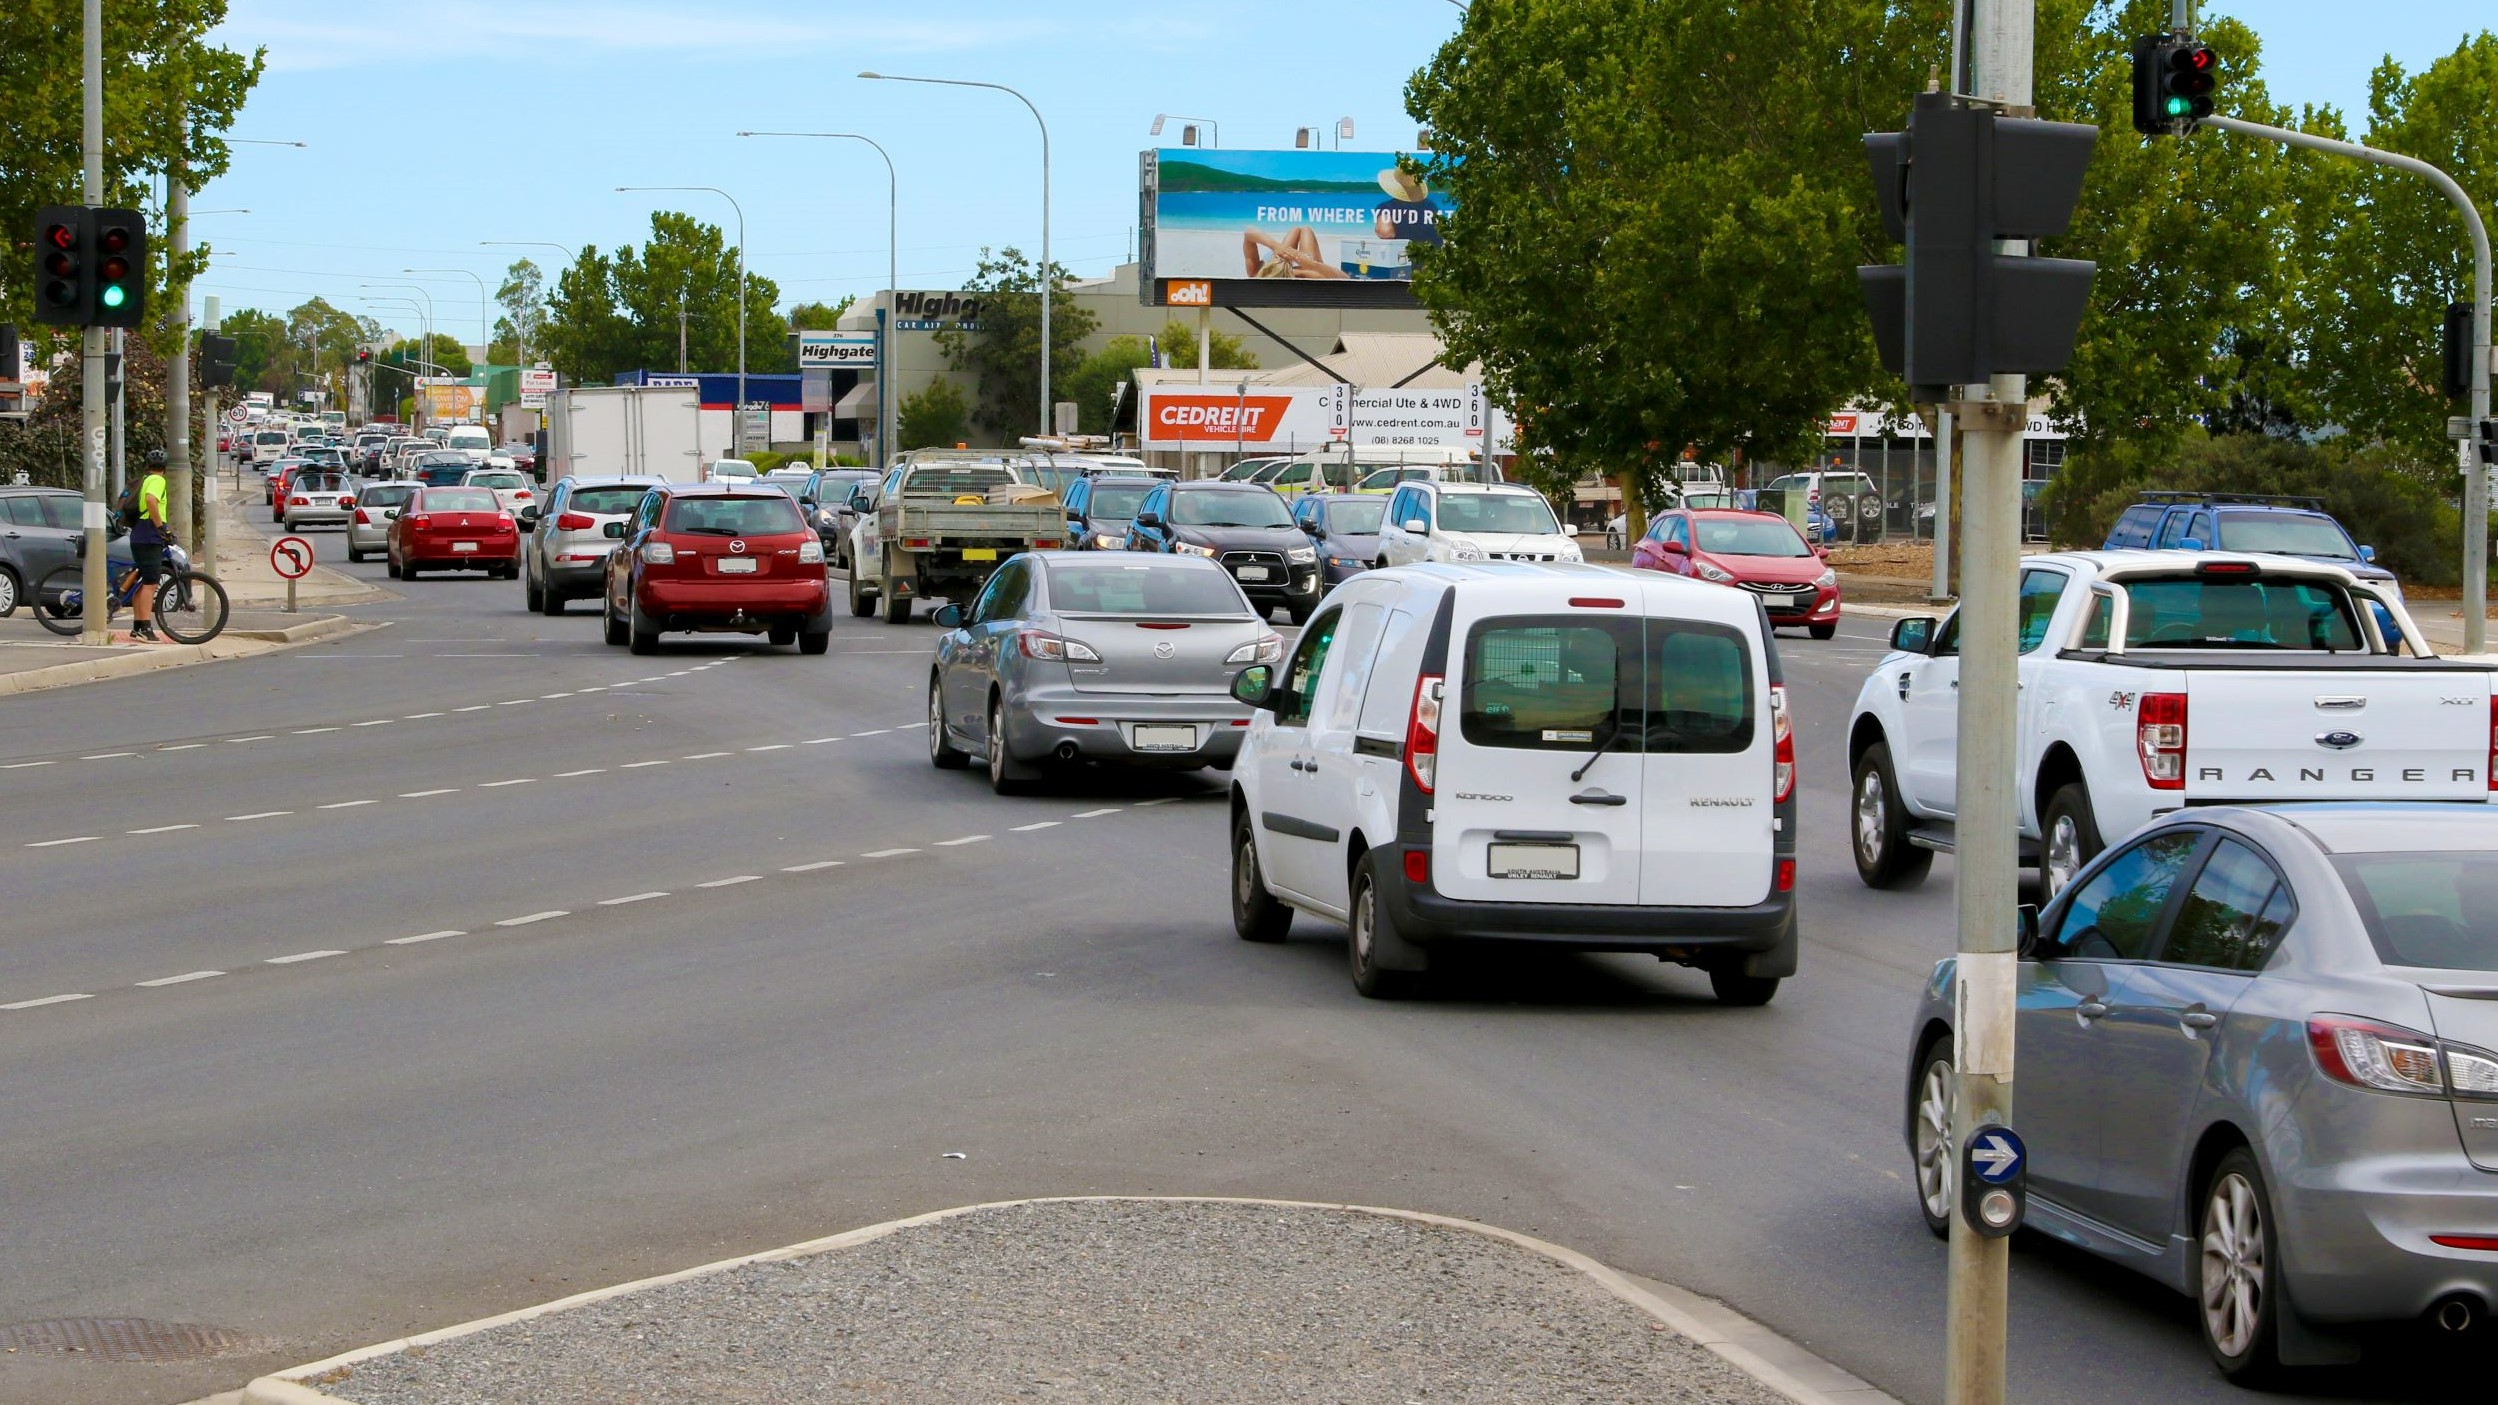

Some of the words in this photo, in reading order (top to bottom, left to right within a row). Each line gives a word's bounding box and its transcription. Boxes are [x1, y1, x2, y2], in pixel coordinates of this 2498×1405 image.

[1257, 206, 1302, 222] FROM
[1308, 207, 1365, 223] WHERE
[1371, 208, 1418, 225] YOU'D
[897, 321, 916, 329] CAR
[801, 345, 875, 360] Highgate
[1318, 397, 1392, 409] Cmercial
[1396, 398, 1416, 409] Ute
[1420, 400, 1429, 409] &
[1432, 399, 1461, 409] 4WD
[232, 408, 244, 417] 60
[1160, 405, 1265, 426] CEDRENT
[1204, 425, 1237, 433] VEHICLE
[1371, 436, 1389, 445] (08)
[1392, 436, 1415, 445] 8268
[1418, 437, 1440, 445] 1025
[2199, 767, 2476, 782] RANGER
[1690, 797, 1756, 807] RENAULT
